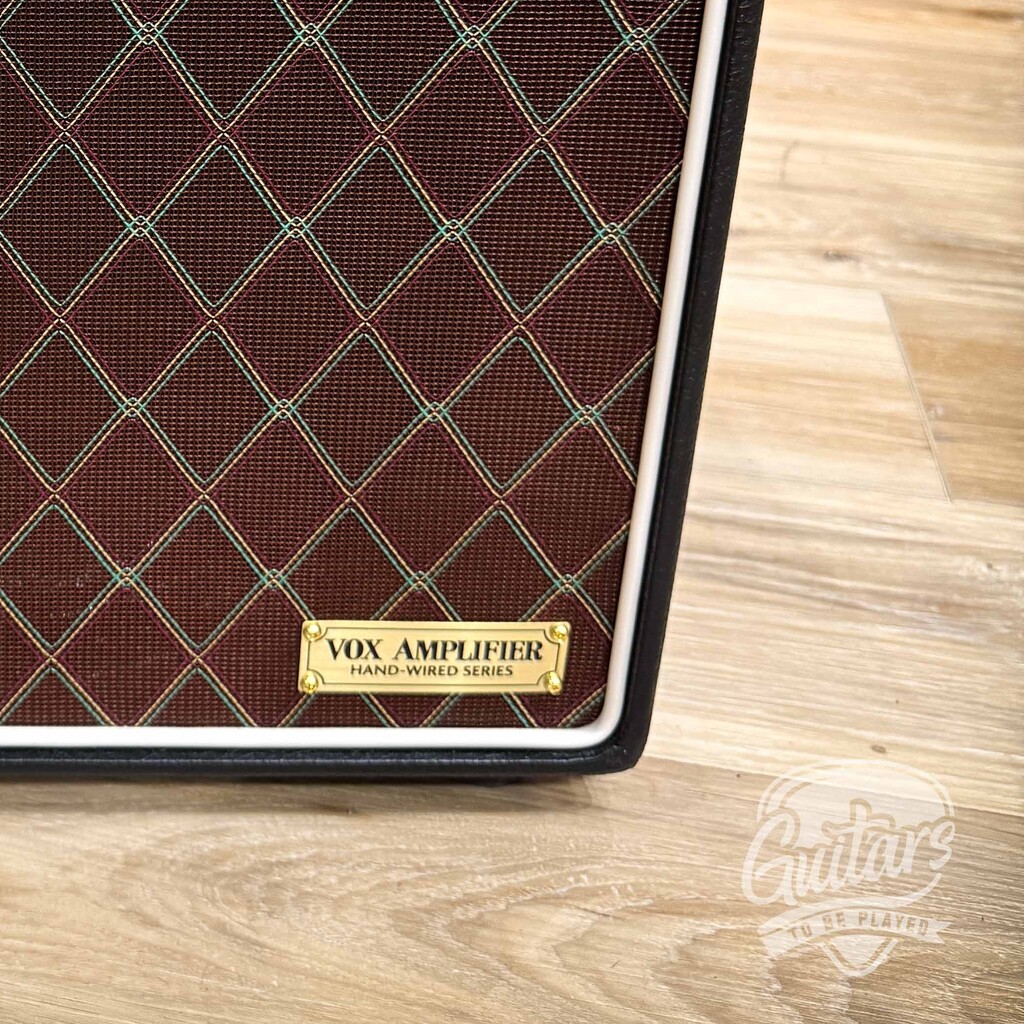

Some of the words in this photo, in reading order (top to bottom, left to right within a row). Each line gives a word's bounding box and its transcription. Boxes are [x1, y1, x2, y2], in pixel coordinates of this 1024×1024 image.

[325, 637, 383, 661] VOX
[392, 637, 543, 662] AMPLIFIER
[350, 663, 459, 677] HAND-WIRED
[462, 664, 514, 678] SERIES
